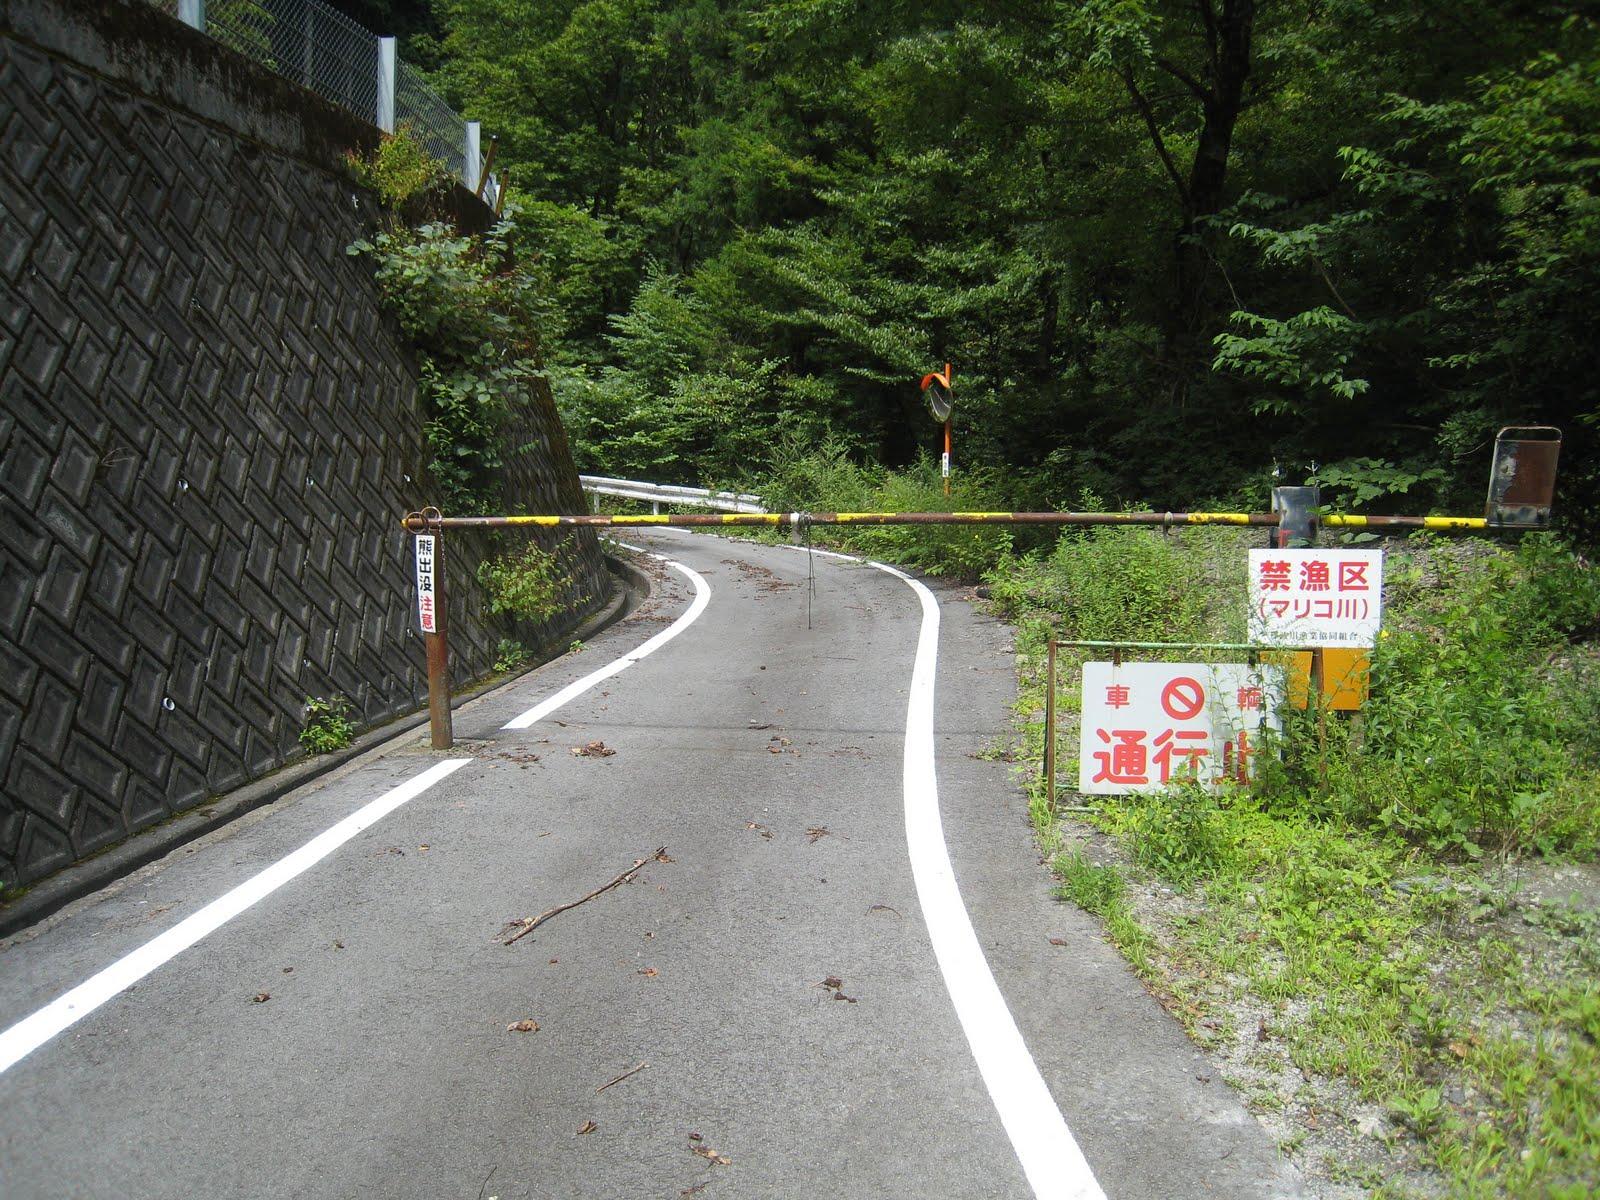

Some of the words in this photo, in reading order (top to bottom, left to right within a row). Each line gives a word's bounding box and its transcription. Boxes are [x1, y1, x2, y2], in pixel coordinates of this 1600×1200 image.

[418, 539, 433, 630] 熊出没注意
[1259, 560, 1370, 592] 禁漁区
